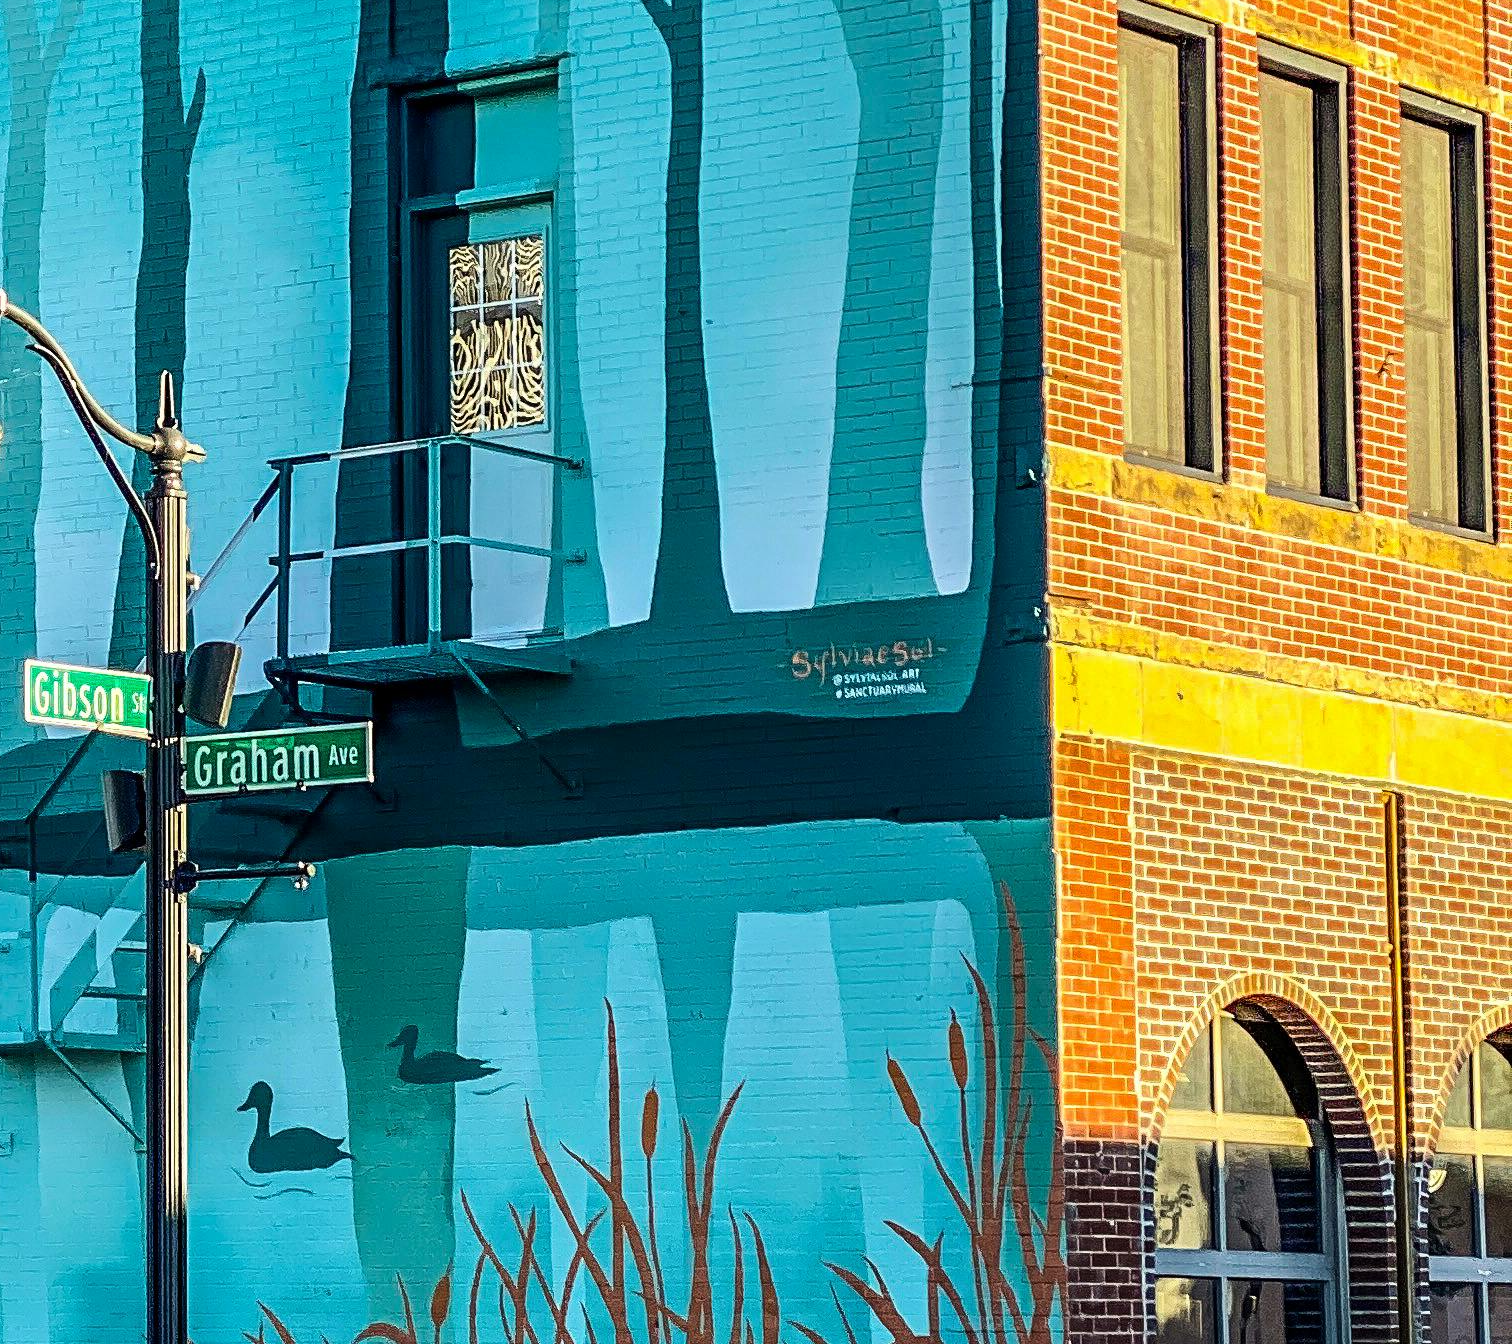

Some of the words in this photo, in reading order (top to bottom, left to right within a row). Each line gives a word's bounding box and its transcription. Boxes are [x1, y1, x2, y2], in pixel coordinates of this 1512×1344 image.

[34, 669, 124, 722] Gibson
[194, 738, 320, 787] Graham
[328, 744, 359, 766] Ave
